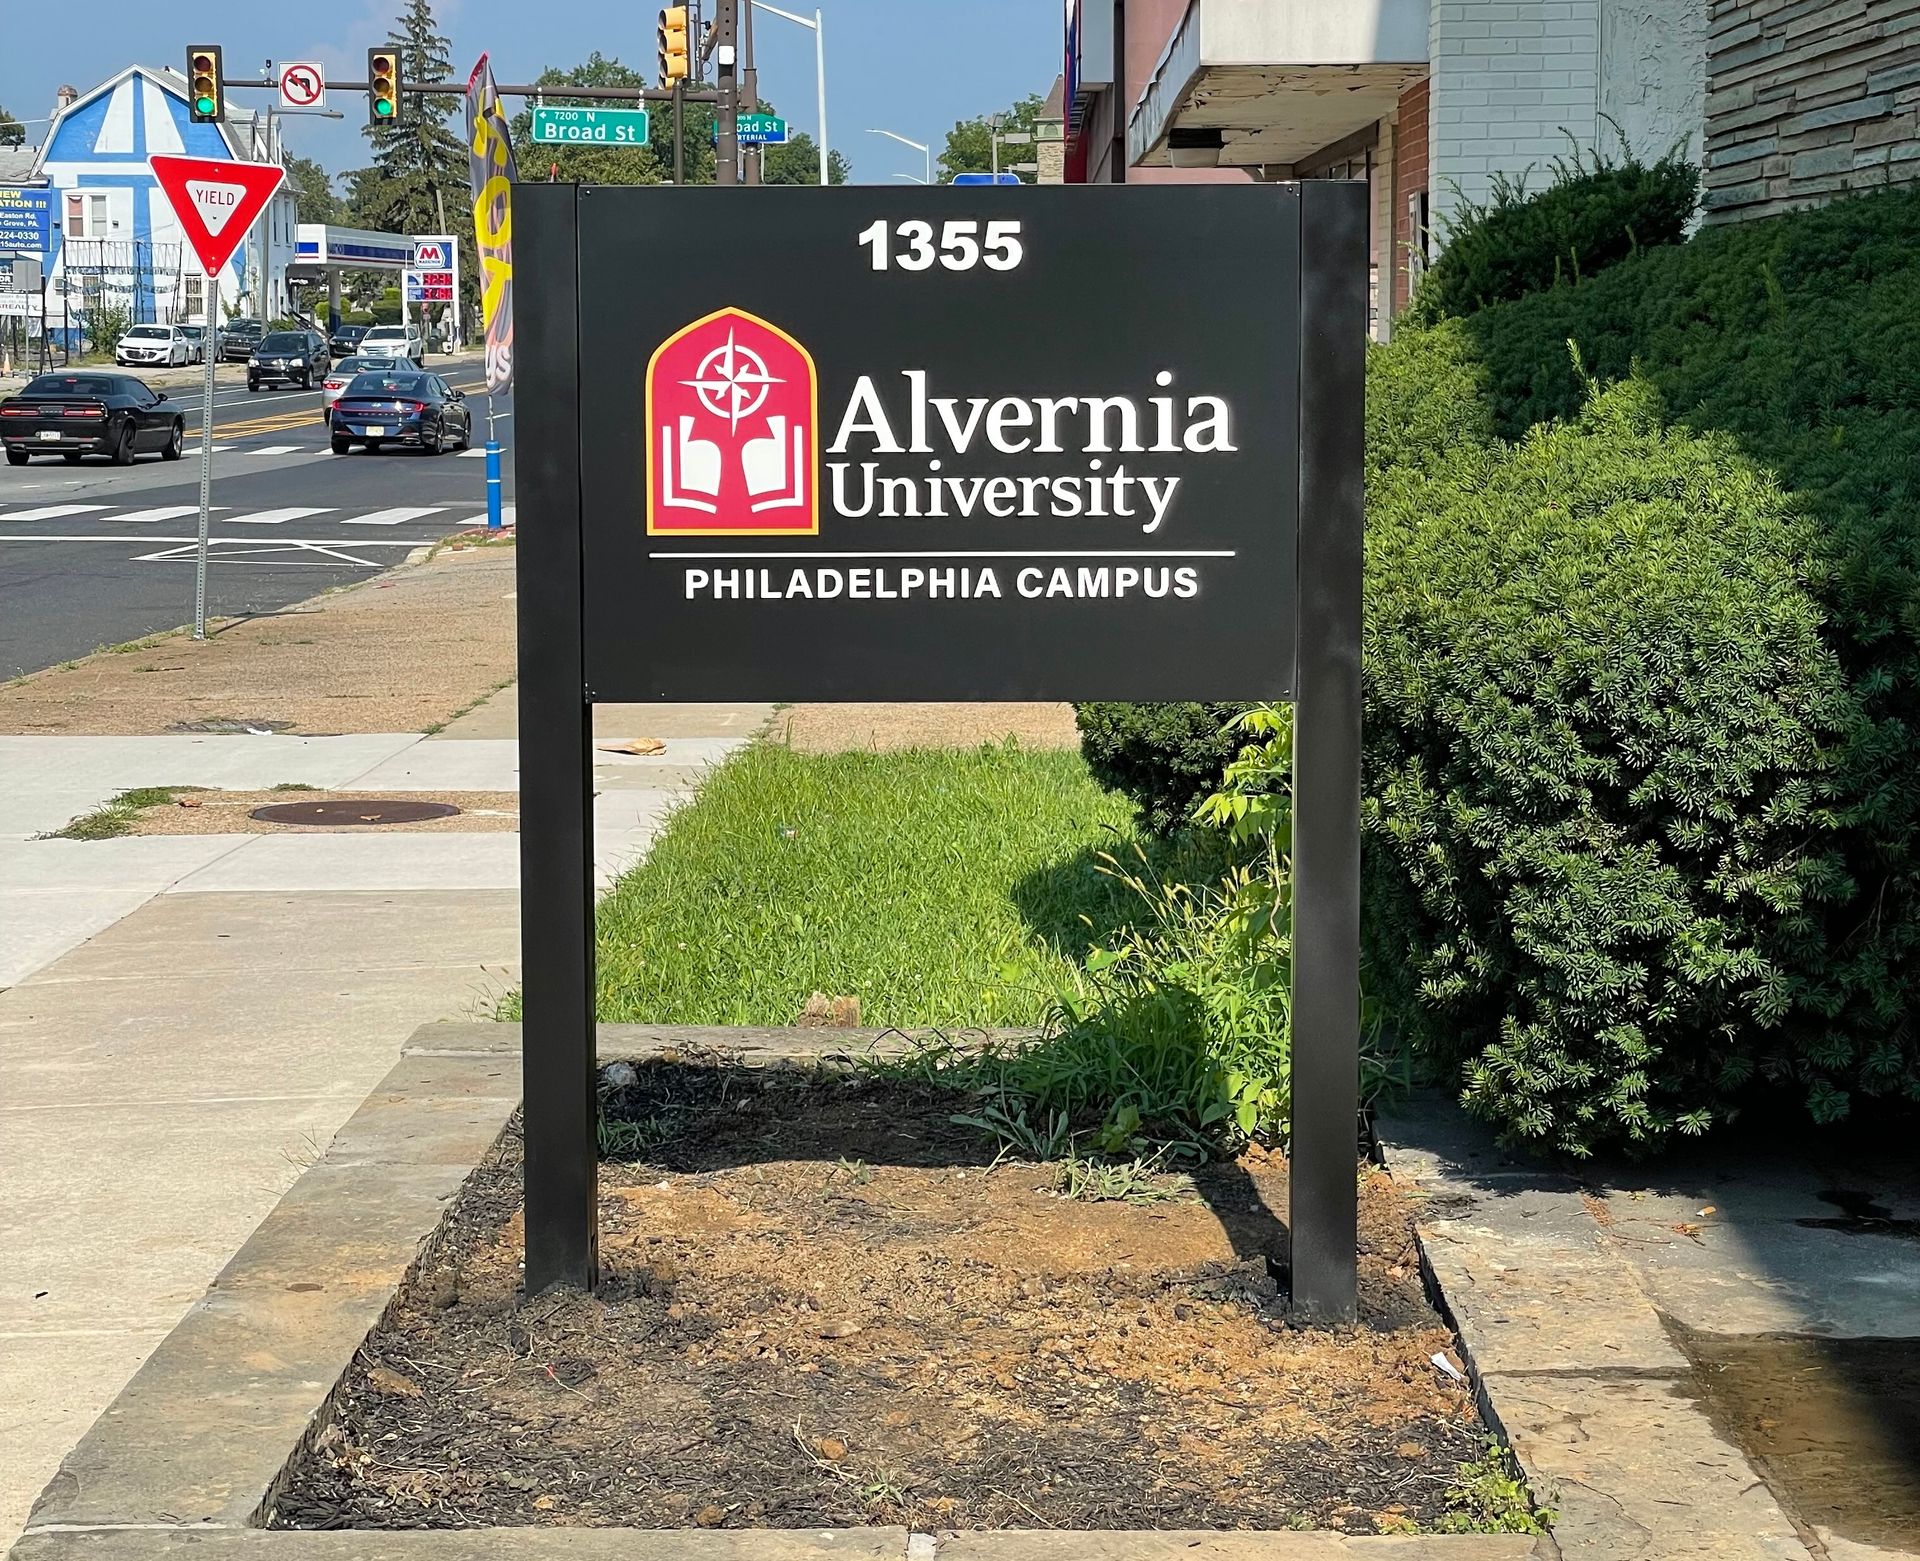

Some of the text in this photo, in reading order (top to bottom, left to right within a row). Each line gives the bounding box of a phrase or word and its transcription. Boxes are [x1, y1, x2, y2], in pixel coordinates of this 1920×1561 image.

[555, 112, 595, 122] 7200 N
[545, 123, 635, 141] Broad St
[765, 121, 778, 132] St
[196, 189, 235, 206] YIELD
[420, 247, 440, 260] M
[858, 219, 1024, 271] 1355
[825, 369, 1239, 454] Alvernia
[825, 458, 1181, 534] University
[684, 567, 1199, 600] PHILADELPHIA CAMPUS
